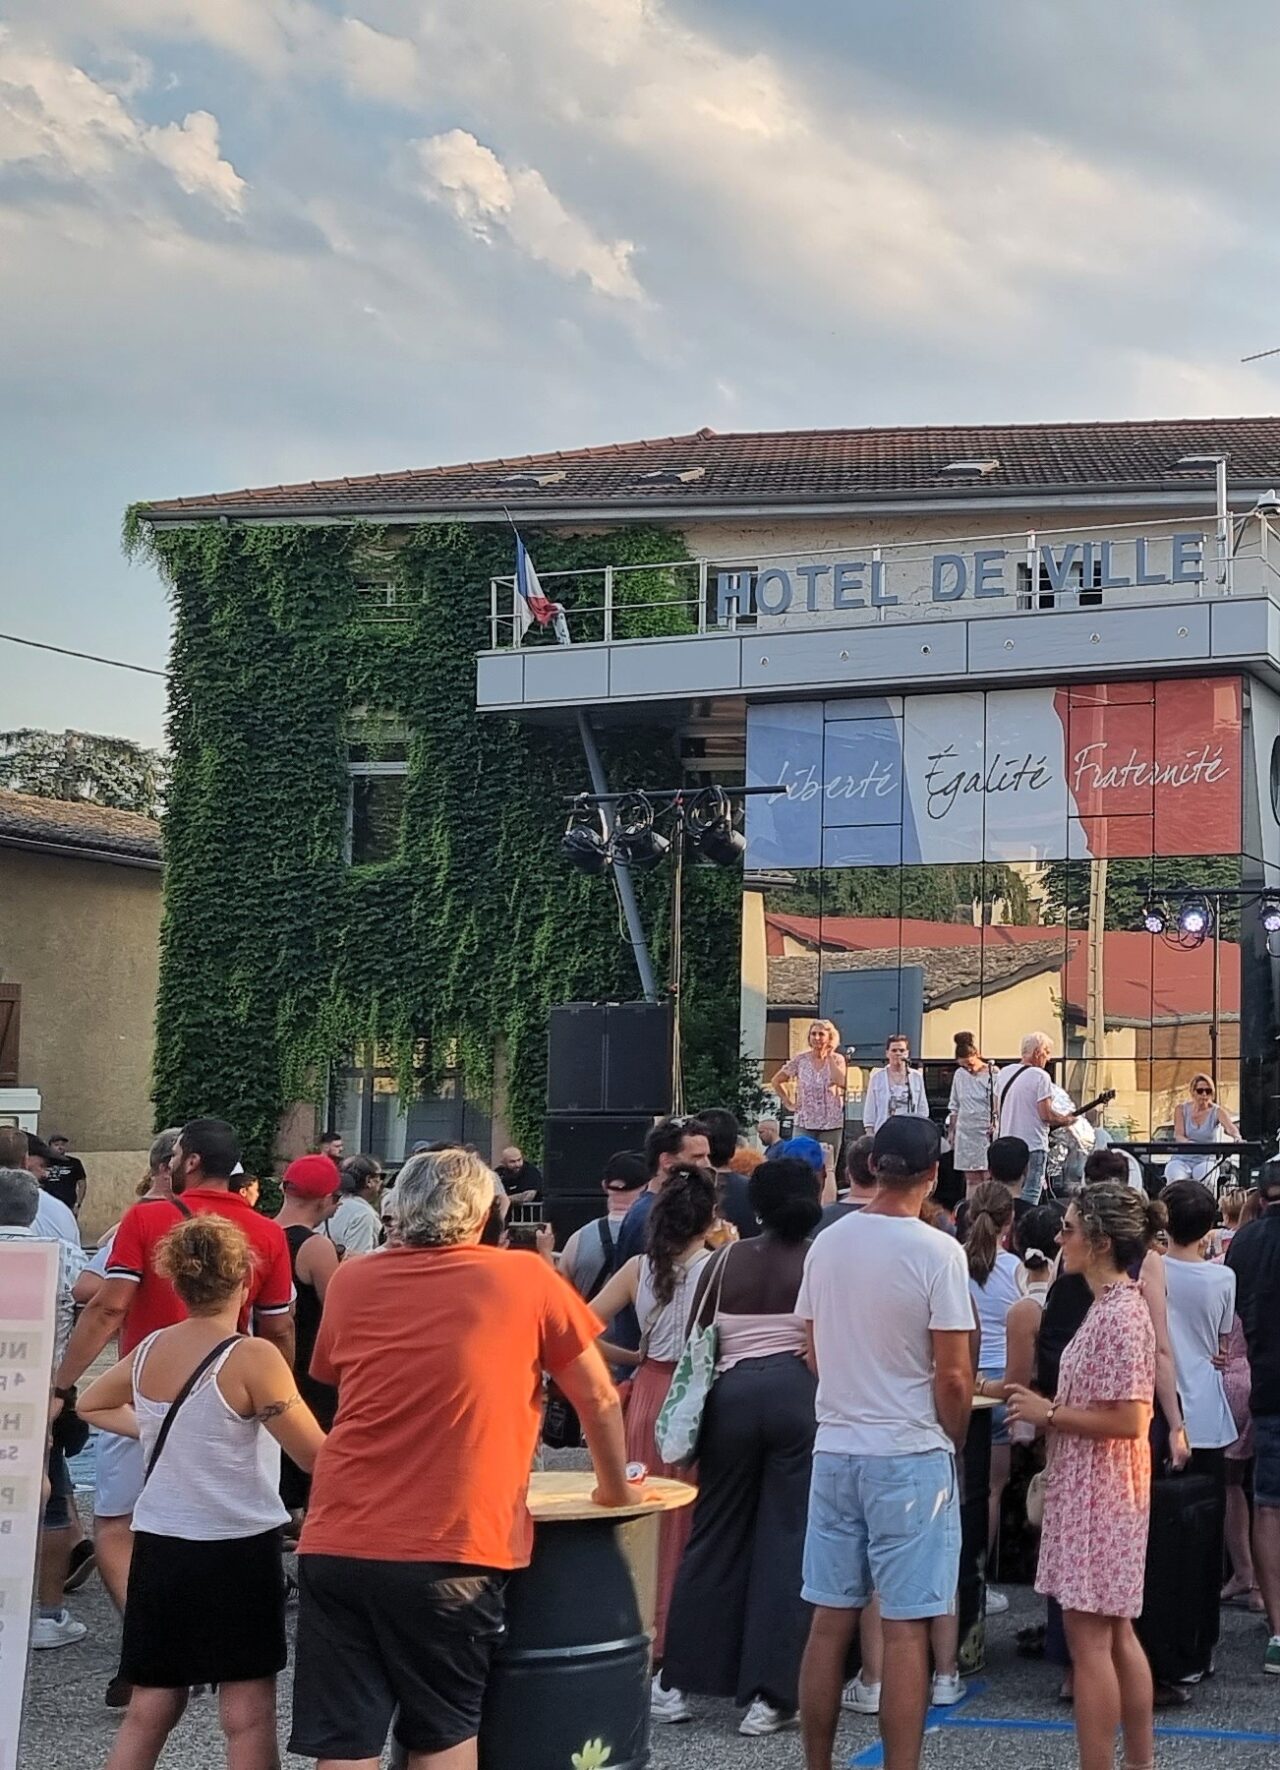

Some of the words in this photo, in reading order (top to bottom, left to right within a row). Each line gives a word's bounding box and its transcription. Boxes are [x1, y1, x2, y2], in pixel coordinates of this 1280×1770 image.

[717, 561, 898, 618] HOTEL
[932, 550, 1004, 601] DE
[1040, 533, 1205, 592] VILLE
[768, 760, 898, 804] Liberté
[925, 744, 1052, 819] Égalité
[1074, 742, 1230, 792] Fraternité
